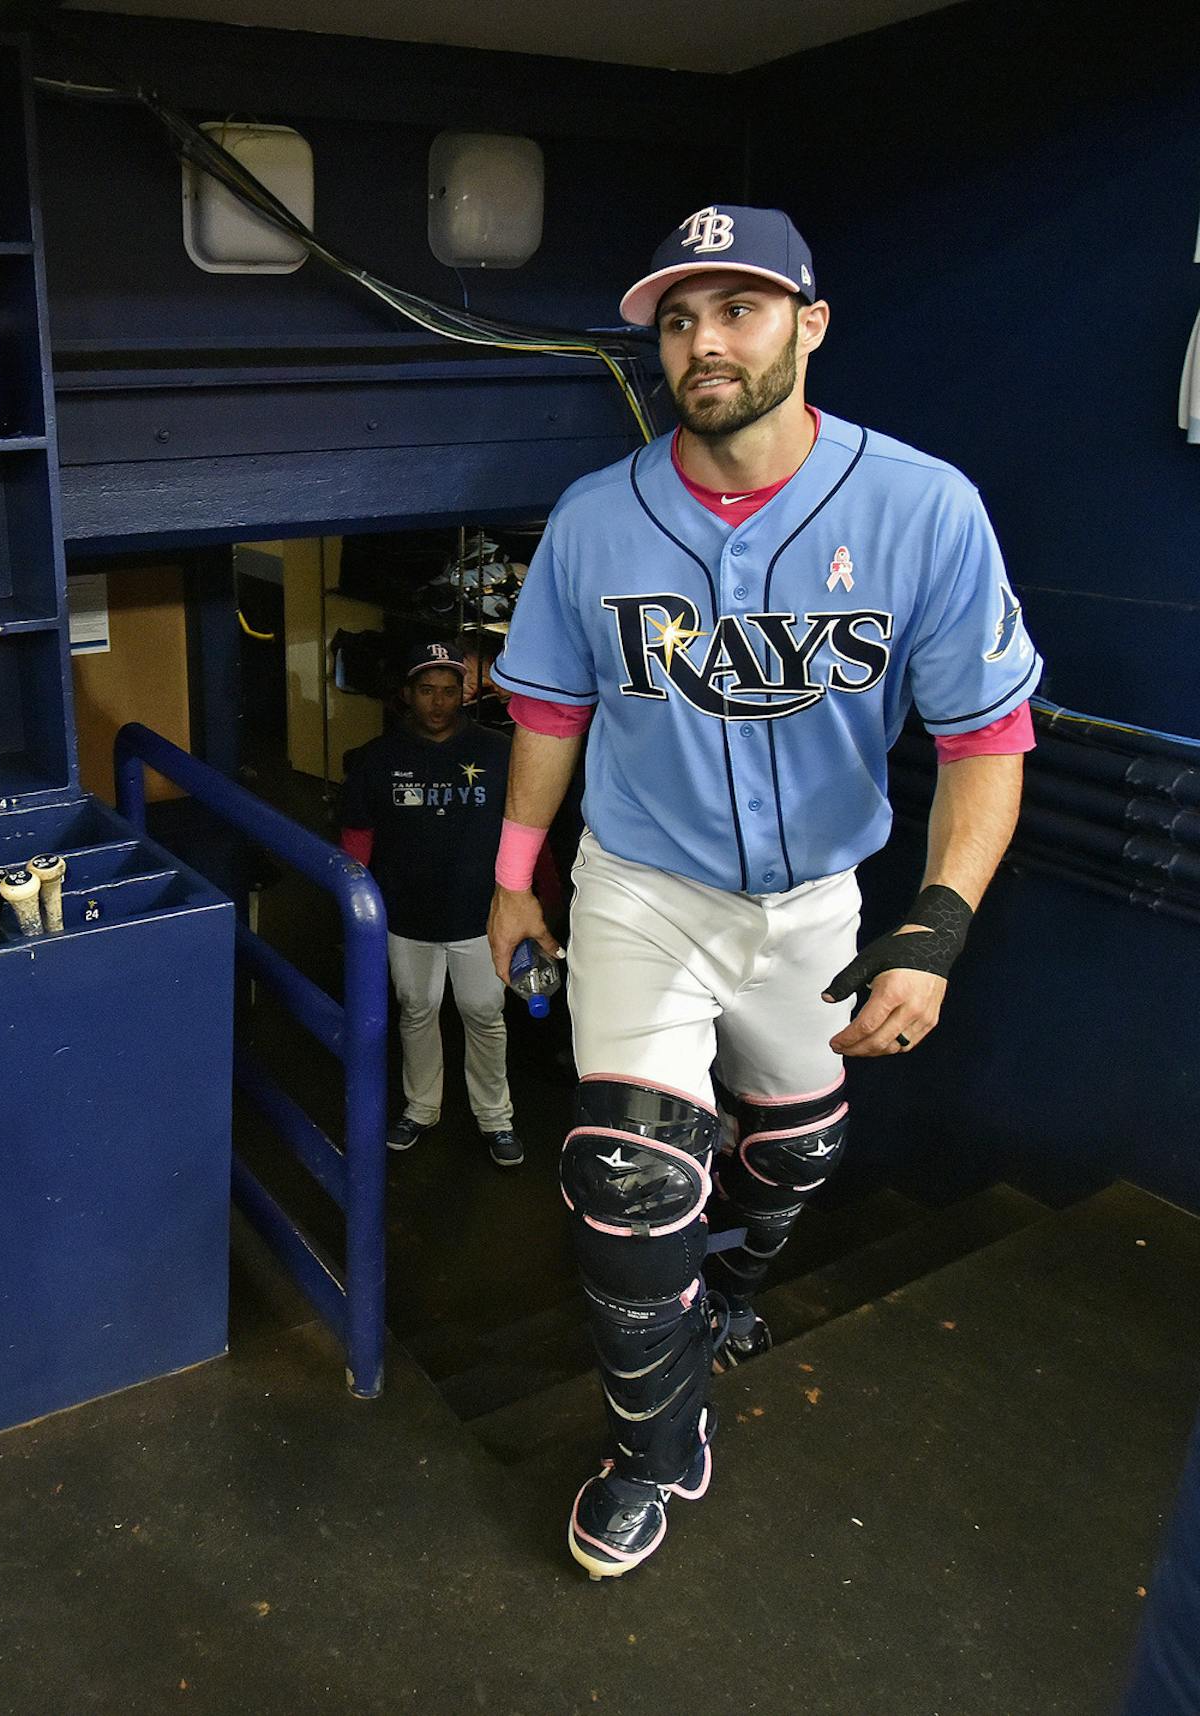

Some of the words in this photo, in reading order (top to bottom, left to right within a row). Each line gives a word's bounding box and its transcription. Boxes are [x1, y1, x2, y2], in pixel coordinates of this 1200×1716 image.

[680, 206, 734, 253] TB
[427, 644, 449, 660] TB
[601, 592, 893, 722] RAYS
[426, 786, 486, 806] RAYS
[85, 908, 99, 921] 24
